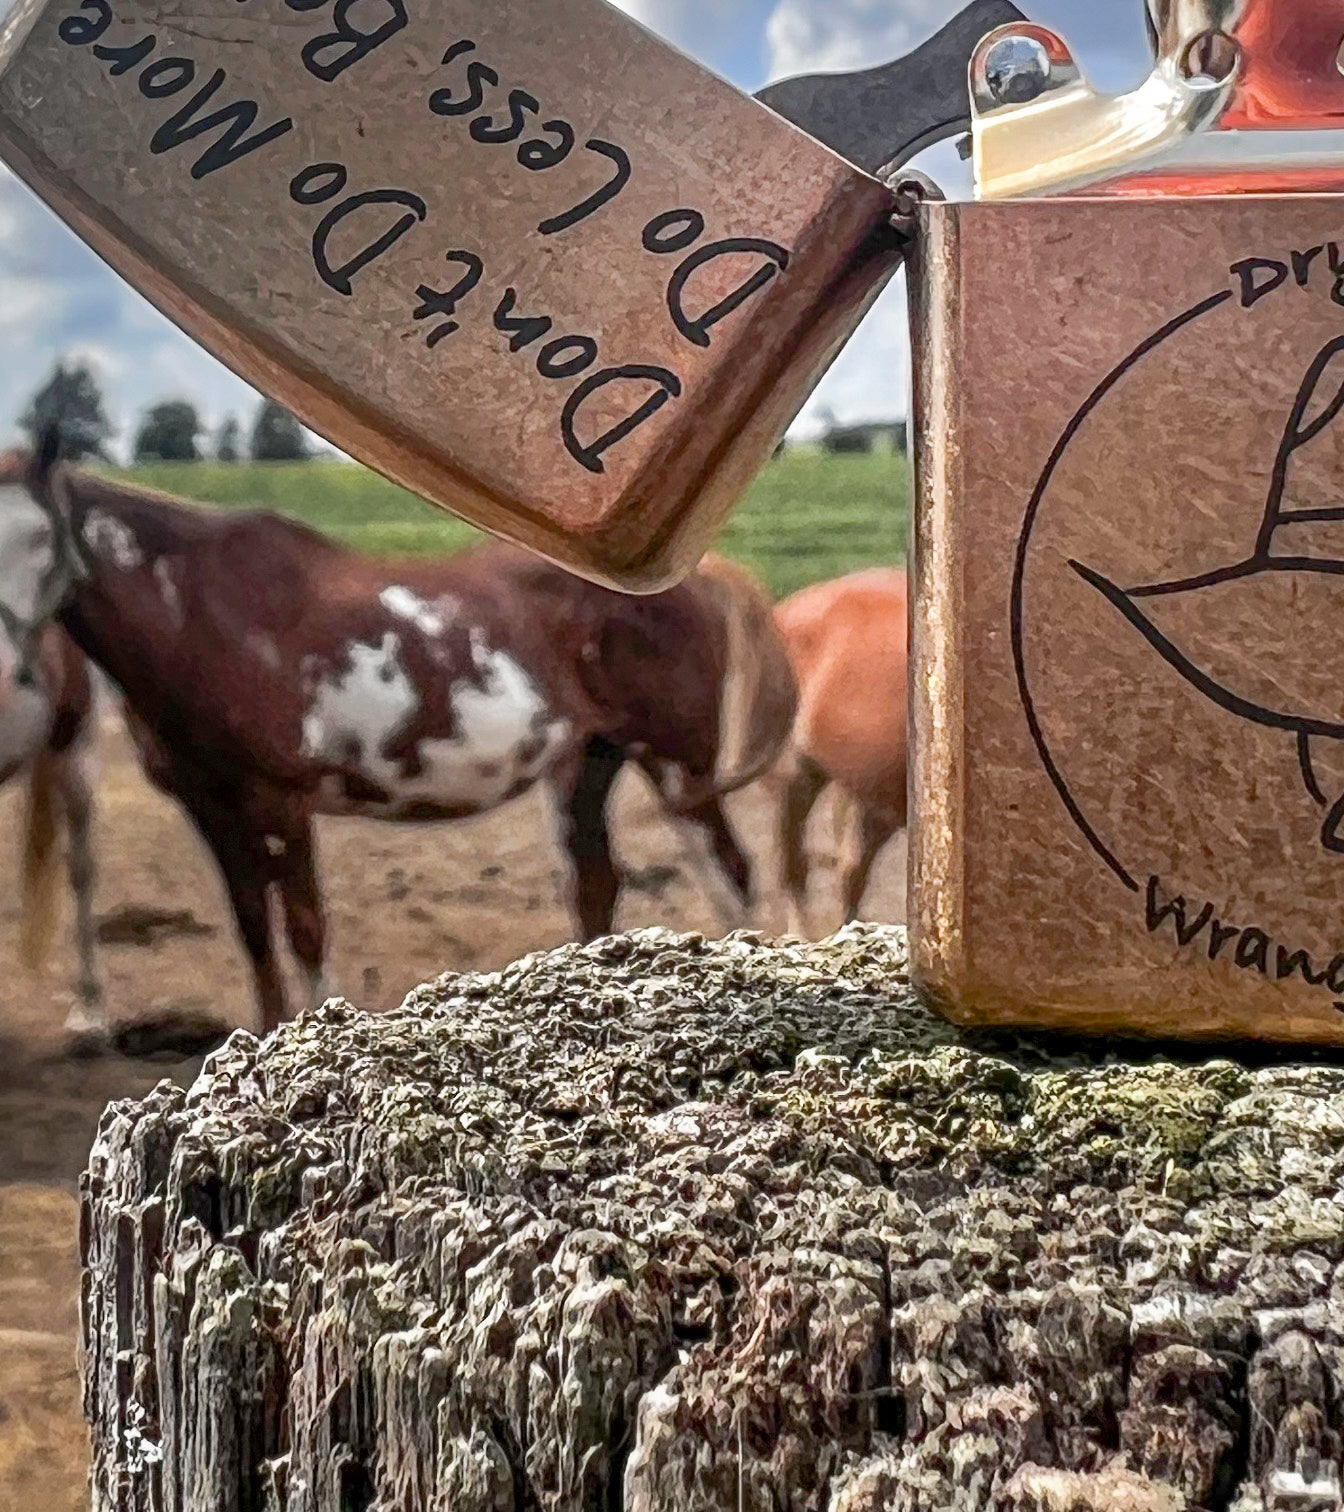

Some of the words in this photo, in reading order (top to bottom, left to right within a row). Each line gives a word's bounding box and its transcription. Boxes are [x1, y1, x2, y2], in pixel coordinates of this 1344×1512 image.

[428, 41, 631, 235] Less,
[289, 163, 427, 295] Do
[642, 208, 788, 347] Do
[412, 249, 681, 473] Don't
